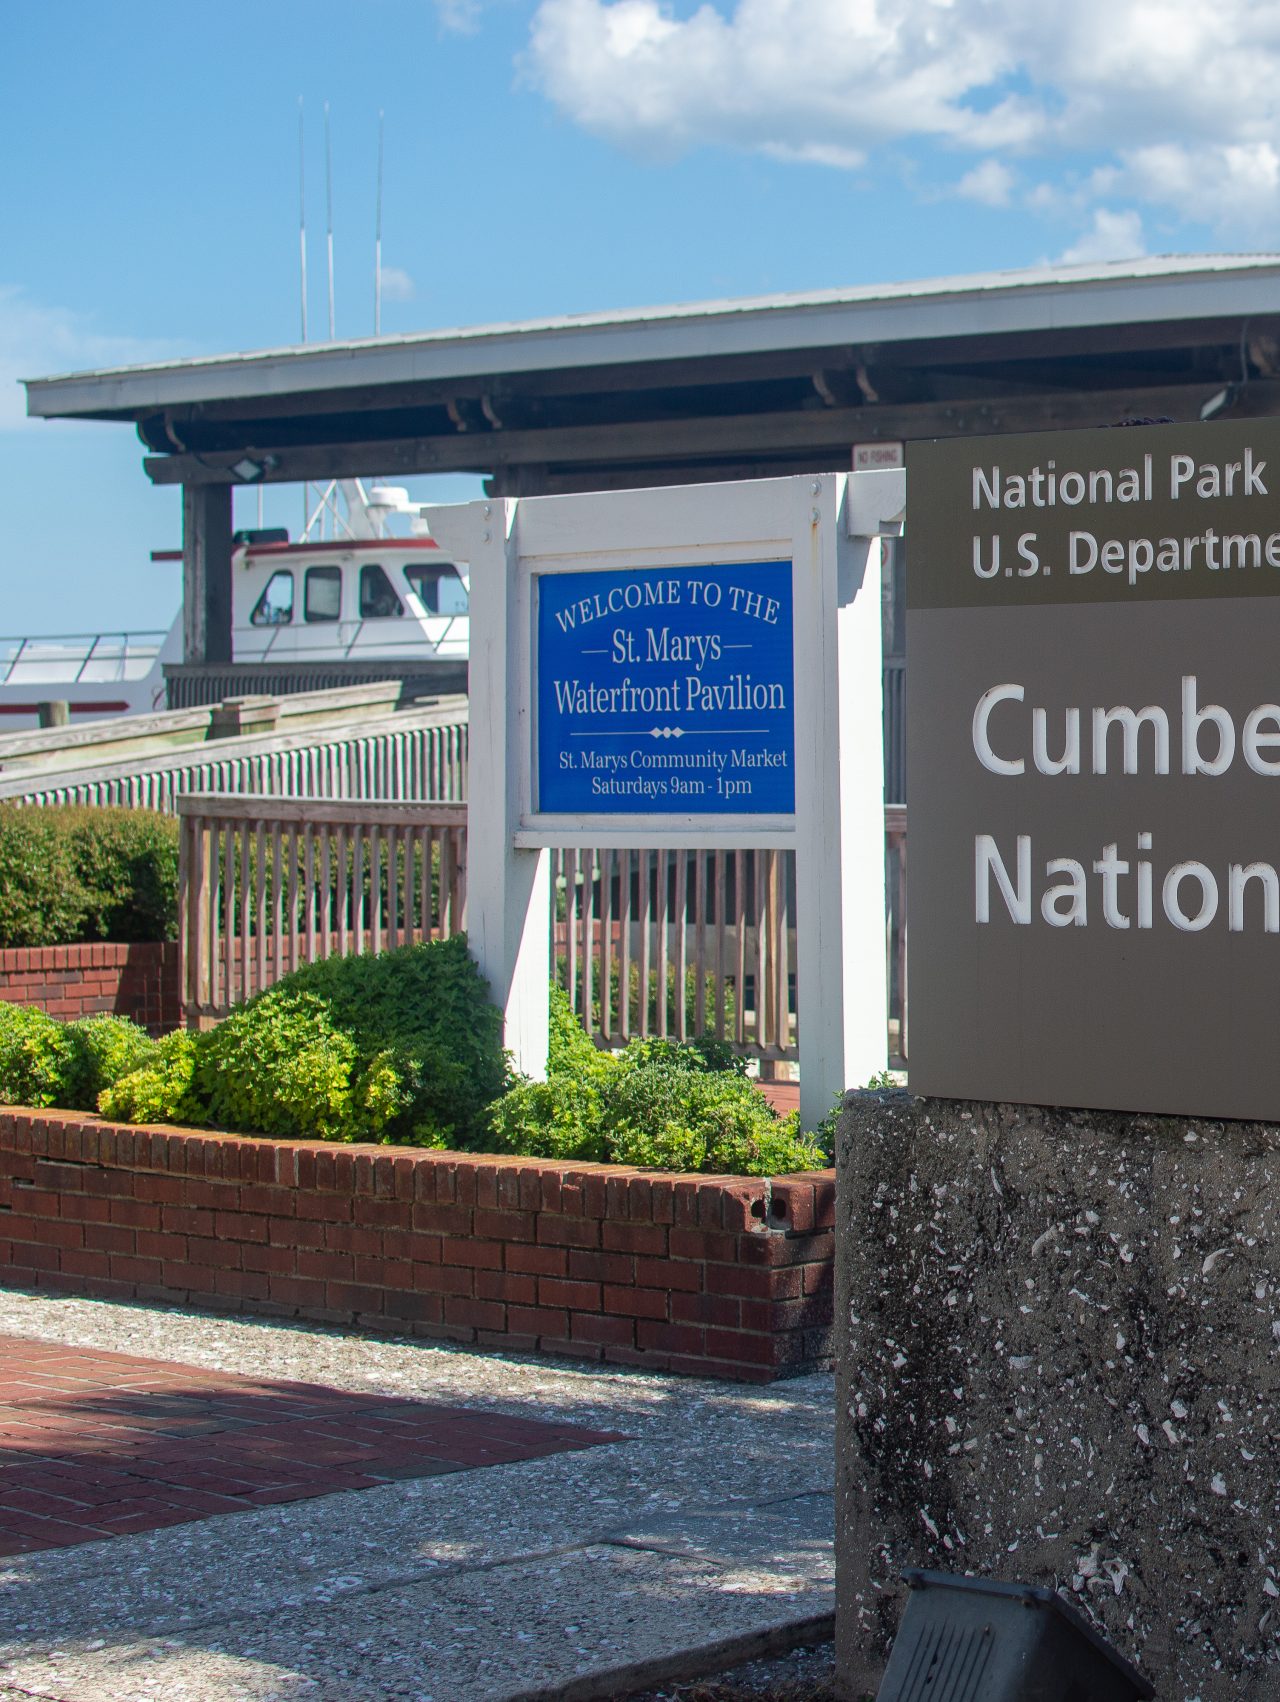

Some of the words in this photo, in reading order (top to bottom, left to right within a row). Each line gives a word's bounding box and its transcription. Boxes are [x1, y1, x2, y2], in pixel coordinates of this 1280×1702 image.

[972, 453, 1153, 510] National
[1170, 447, 1269, 500] Park
[972, 532, 1051, 579] U.S.
[555, 580, 681, 634] WELCOME
[687, 580, 722, 608] TO
[728, 586, 780, 625] THE
[612, 628, 641, 664] St.
[645, 627, 722, 672] Marys
[553, 677, 681, 715] Waterfront
[685, 674, 786, 712] Pavilion
[559, 751, 577, 769] St.
[581, 751, 627, 774] Marys
[630, 750, 727, 773] Community
[730, 748, 788, 768] Market
[591, 776, 667, 799] Saturdays
[670, 776, 705, 795] 9am
[716, 776, 752, 800] 1pm
